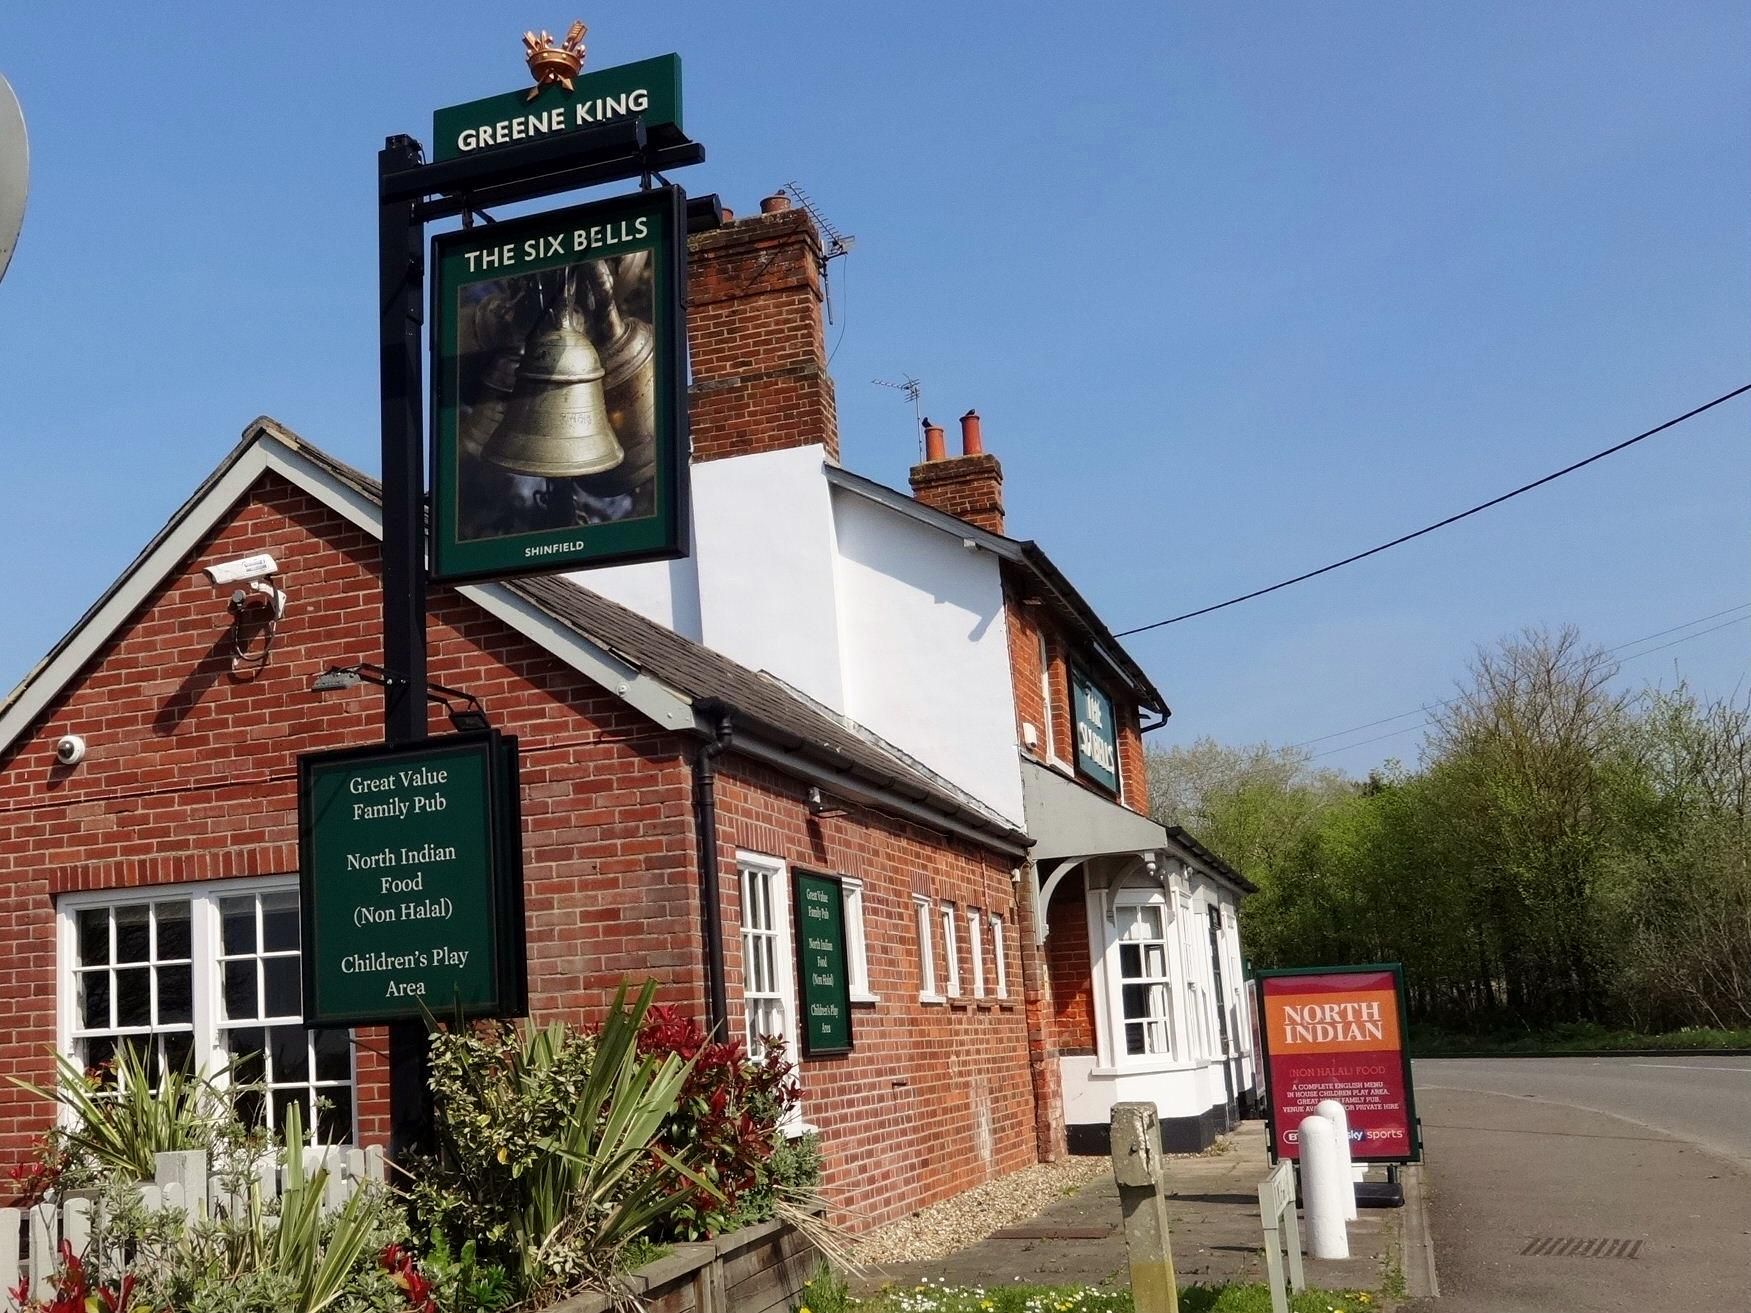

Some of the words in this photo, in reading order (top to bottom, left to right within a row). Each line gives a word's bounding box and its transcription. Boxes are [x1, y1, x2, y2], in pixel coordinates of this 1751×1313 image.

[458, 108, 564, 151] GREENE
[576, 89, 648, 124] KING
[465, 243, 515, 272] THE
[524, 234, 564, 261] SIX
[574, 217, 647, 251] BELLS
[525, 542, 584, 556] SHINFIELD
[350, 774, 395, 794] Great
[399, 767, 447, 787] Value
[353, 798, 409, 820] Family
[414, 792, 446, 814] Pub
[347, 849, 395, 871] North
[401, 844, 456, 865] Indian
[381, 872, 423, 894] Food
[354, 906, 395, 927] (Non
[400, 898, 452, 920] Halal)
[432, 947, 469, 968] Play
[386, 980, 426, 997] Area
[1283, 1002, 1380, 1025] NORTH
[1284, 1022, 1382, 1044] INDIAN
[1356, 1066, 1385, 1075] FOOD
[1367, 1130, 1403, 1140] sports
